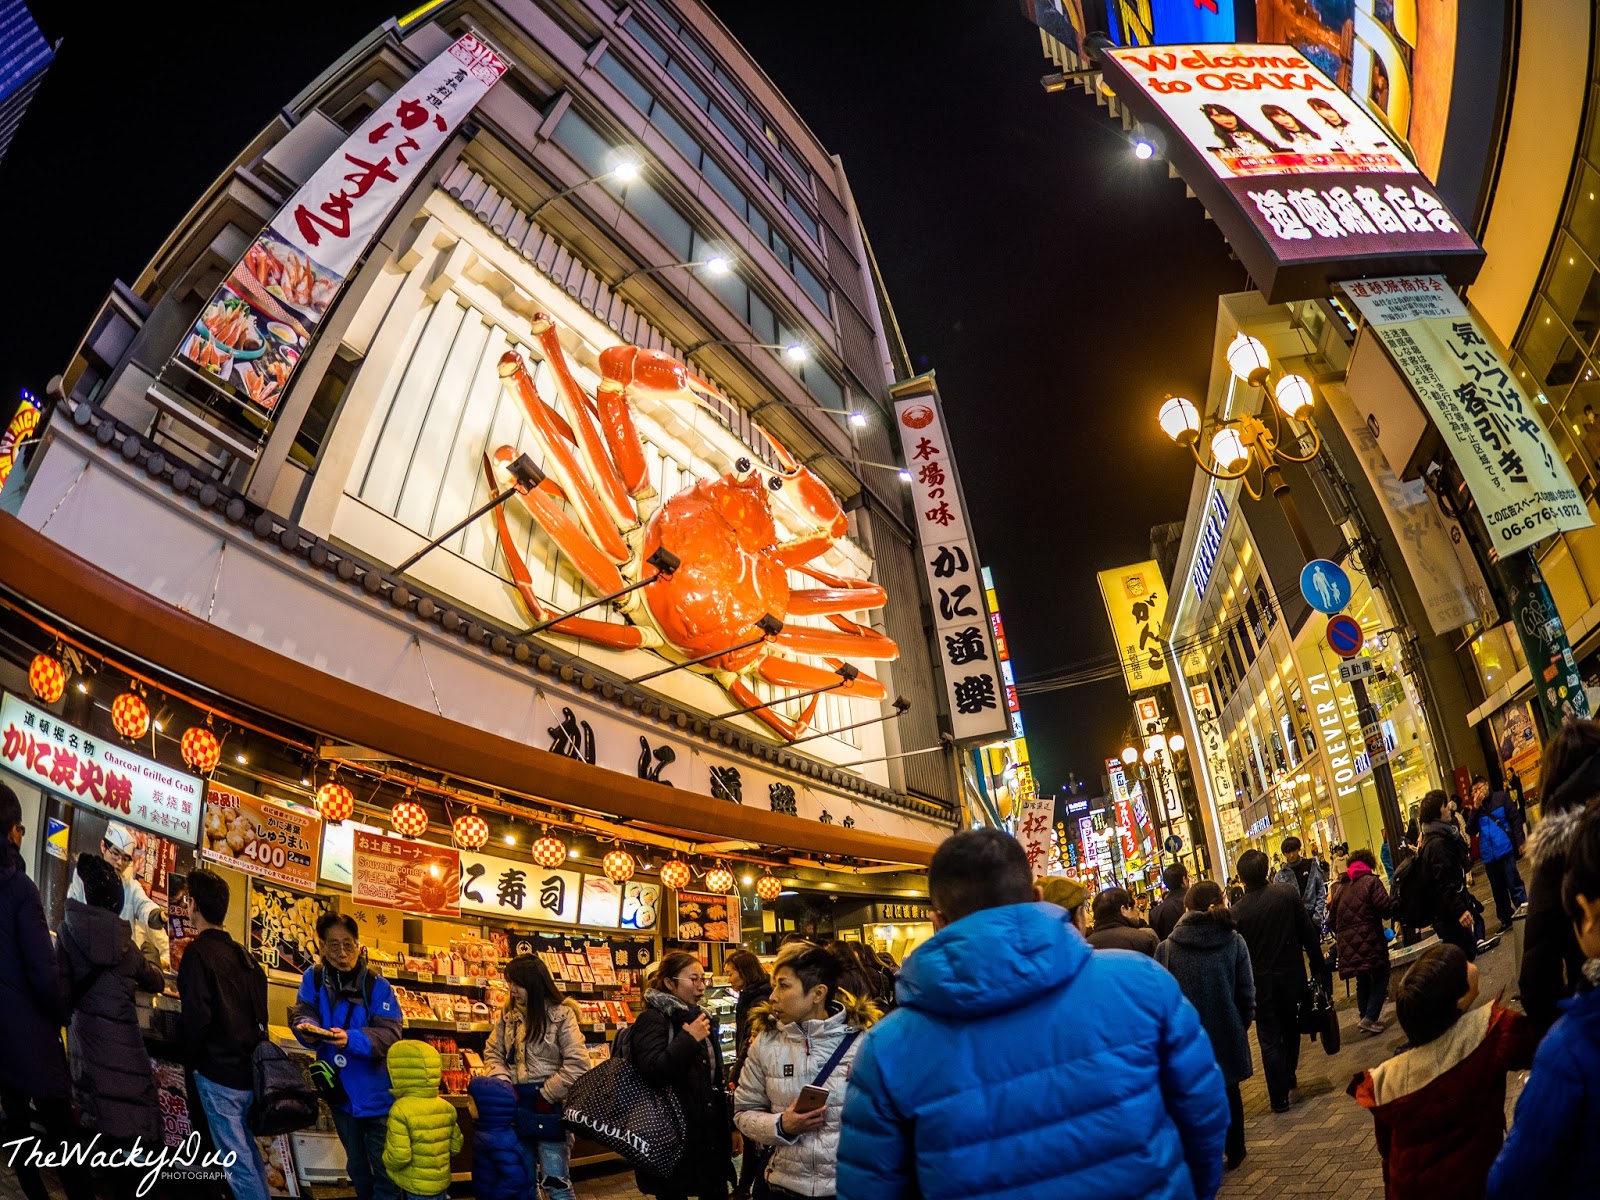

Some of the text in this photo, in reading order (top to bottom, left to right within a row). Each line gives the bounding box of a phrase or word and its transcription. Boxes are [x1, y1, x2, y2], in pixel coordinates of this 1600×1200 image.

[1121, 50, 1310, 73] Welcome
[1148, 72, 1336, 95] to OSAKA
[293, 98, 448, 247] かにすき
[1251, 184, 1460, 240] 道頓堀商店会
[1351, 275, 1446, 299] 道頓堀商店会
[1453, 382, 1529, 483] 客引き
[912, 436, 956, 527] 本場の味
[1501, 503, 1582, 541] 06-6765-1872
[1131, 592, 1171, 671] がんこ
[1307, 672, 1330, 695] 21
[1340, 660, 1372, 679] 自動車
[23, 709, 96, 757] 道頓堀名物
[1316, 699, 1358, 798] FOREVER
[2, 721, 134, 815] かに炭火焼
[104, 751, 195, 794] Charcoal Grilled Crab
[244, 840, 286, 868] 400
[256, 824, 310, 851] しゅうまい
[359, 836, 433, 859] お土産コーナー
[1022, 812, 1049, 878] 松葉
[358, 855, 423, 877] Souvenir corner
[261, 893, 281, 968] かに寿司
